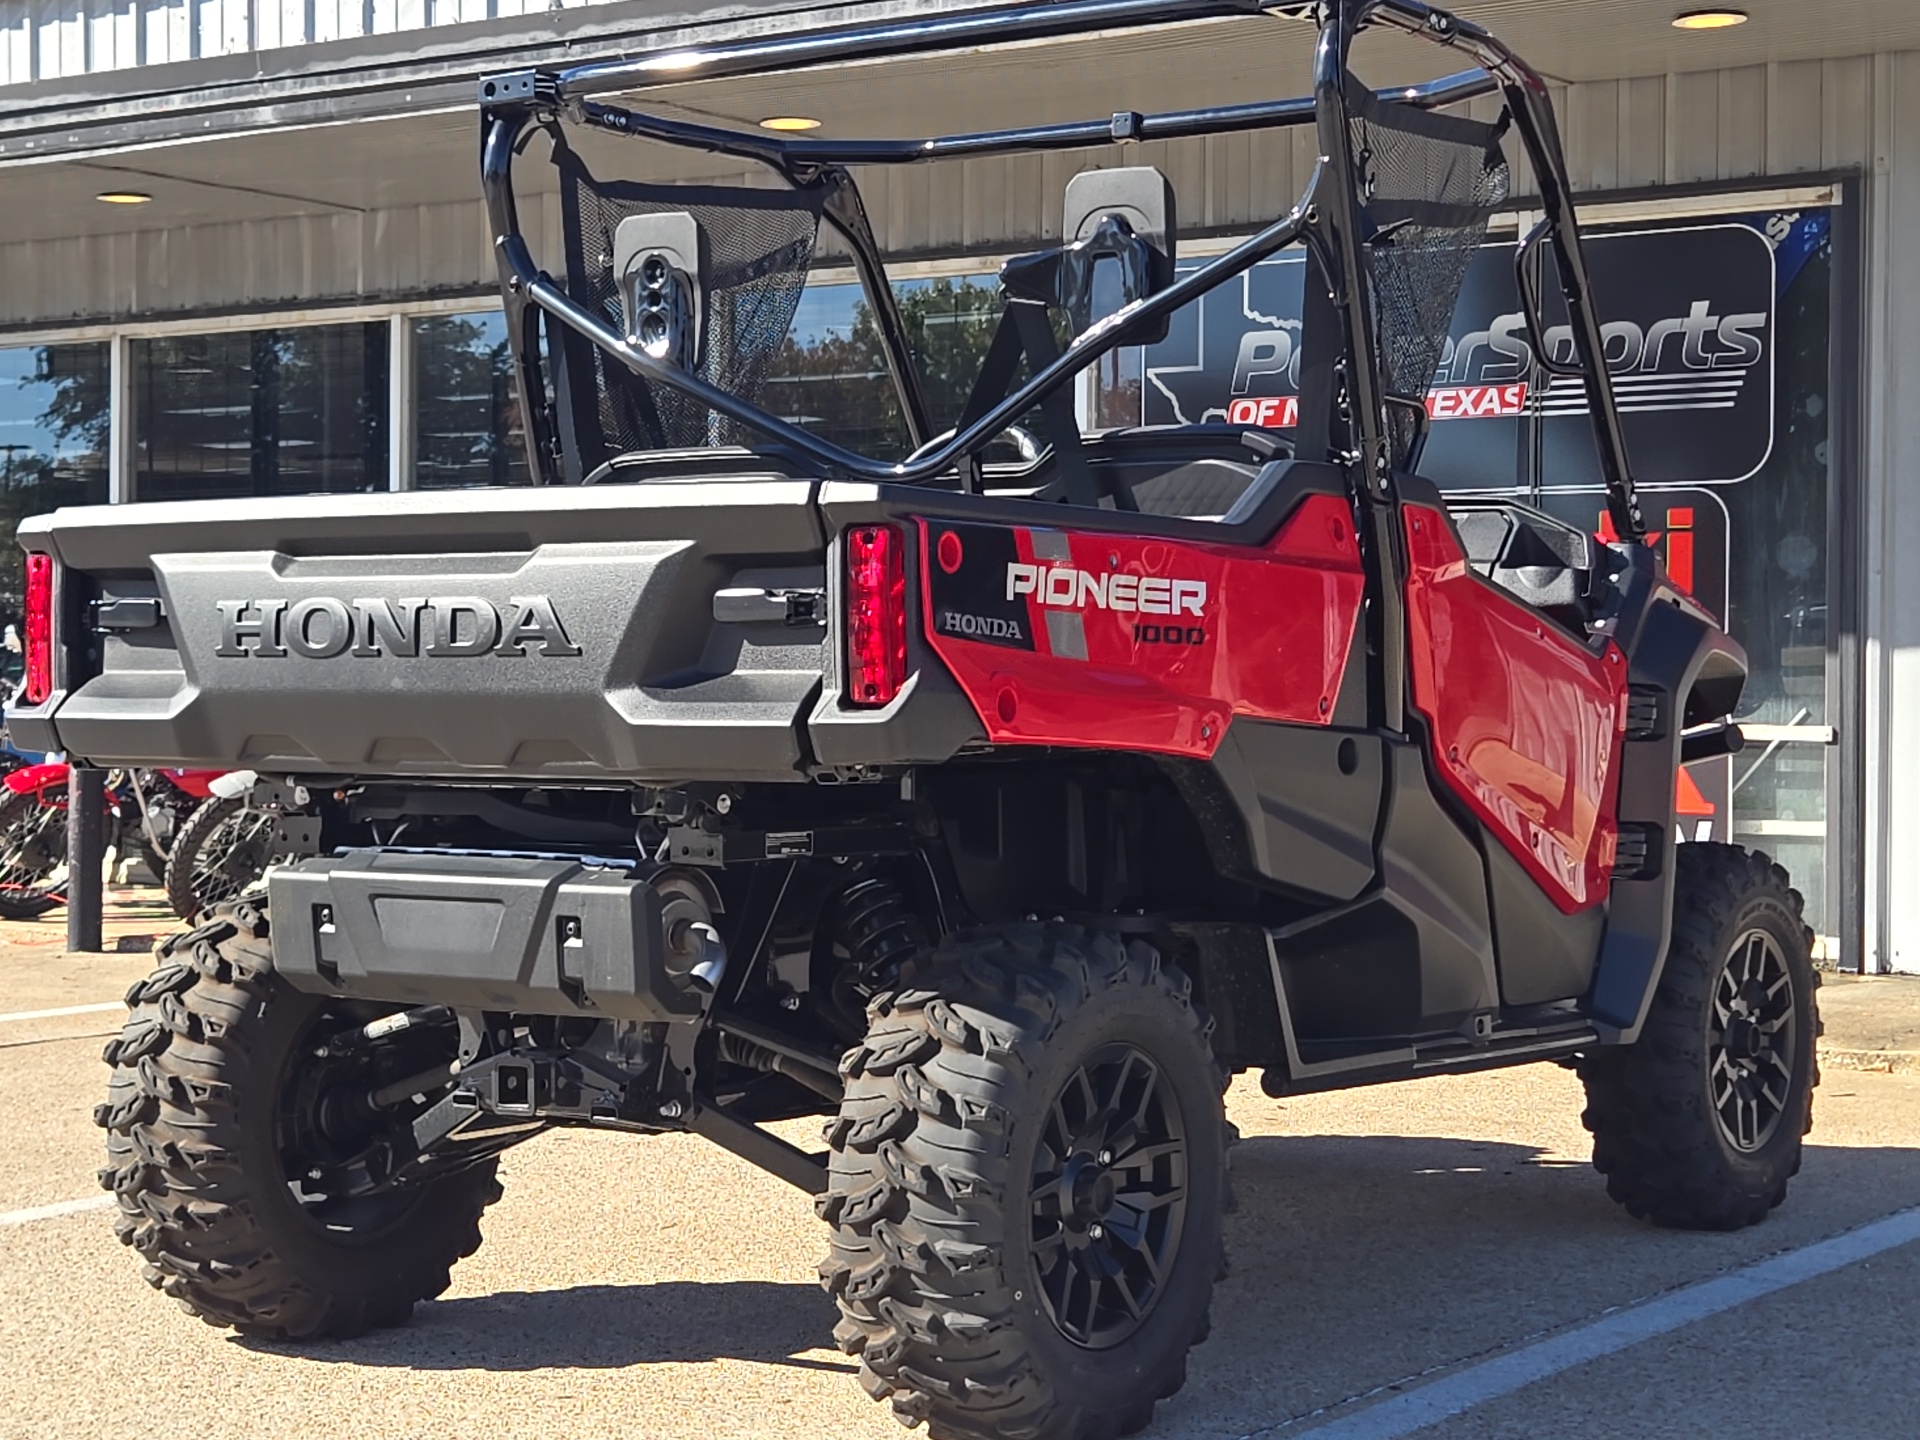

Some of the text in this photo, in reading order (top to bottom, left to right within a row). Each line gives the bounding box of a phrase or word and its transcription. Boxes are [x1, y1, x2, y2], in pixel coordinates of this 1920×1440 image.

[1231, 300, 1767, 395] PrSports
[1233, 399, 1279, 426] OF
[1427, 386, 1520, 417] EXAS
[1006, 562, 1207, 617] PIONEER
[215, 595, 583, 659] HONDA
[944, 611, 1023, 640] HONDA
[1131, 623, 1205, 646] 1000
